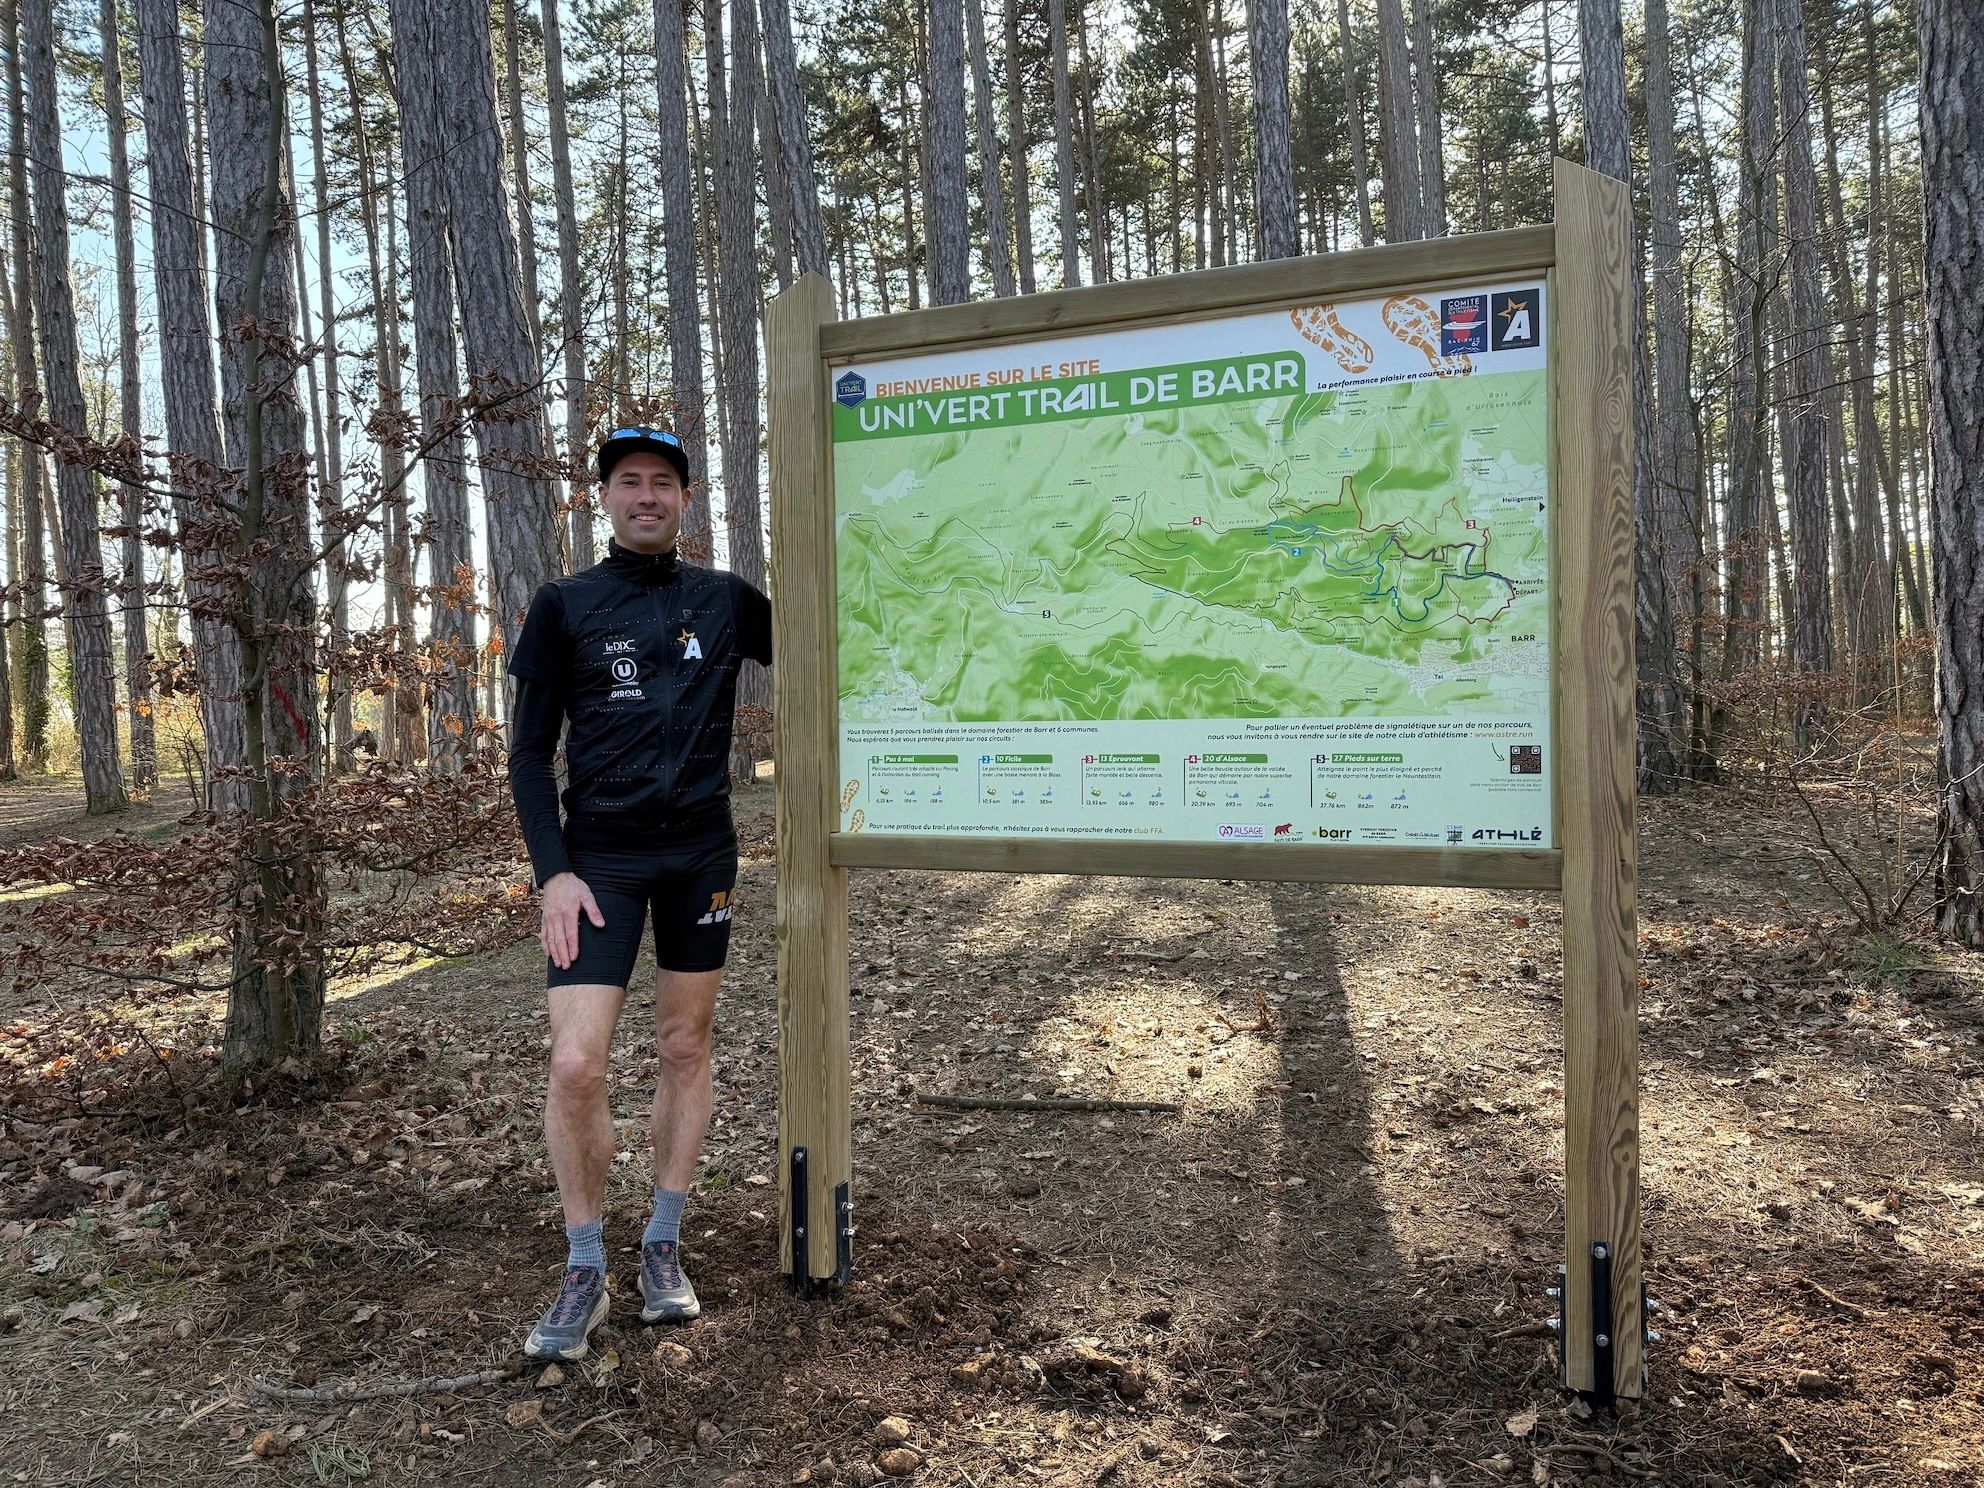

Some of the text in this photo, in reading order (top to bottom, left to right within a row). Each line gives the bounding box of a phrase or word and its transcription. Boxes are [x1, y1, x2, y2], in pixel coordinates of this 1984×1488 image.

[1448, 297, 1480, 308] COMITÉ
[1502, 310, 1531, 342] A
[876, 359, 1100, 398] BIENVENUE SUR LE SITE
[1328, 378, 1378, 390] performance
[1380, 373, 1406, 384] plaisir
[1454, 366, 1472, 376] pied
[840, 386, 862, 394] TRAIL
[860, 359, 1300, 432] UNI'VERT TRAIL DE BARR
[1502, 495, 1544, 503] Heiligenstein
[682, 638, 703, 659] A
[617, 664, 632, 677] U
[611, 689, 642, 698] GIROLD
[1109, 754, 1144, 763] Éprouvant
[1319, 827, 1352, 838] barr
[1472, 827, 1542, 841] ATHLÉ
